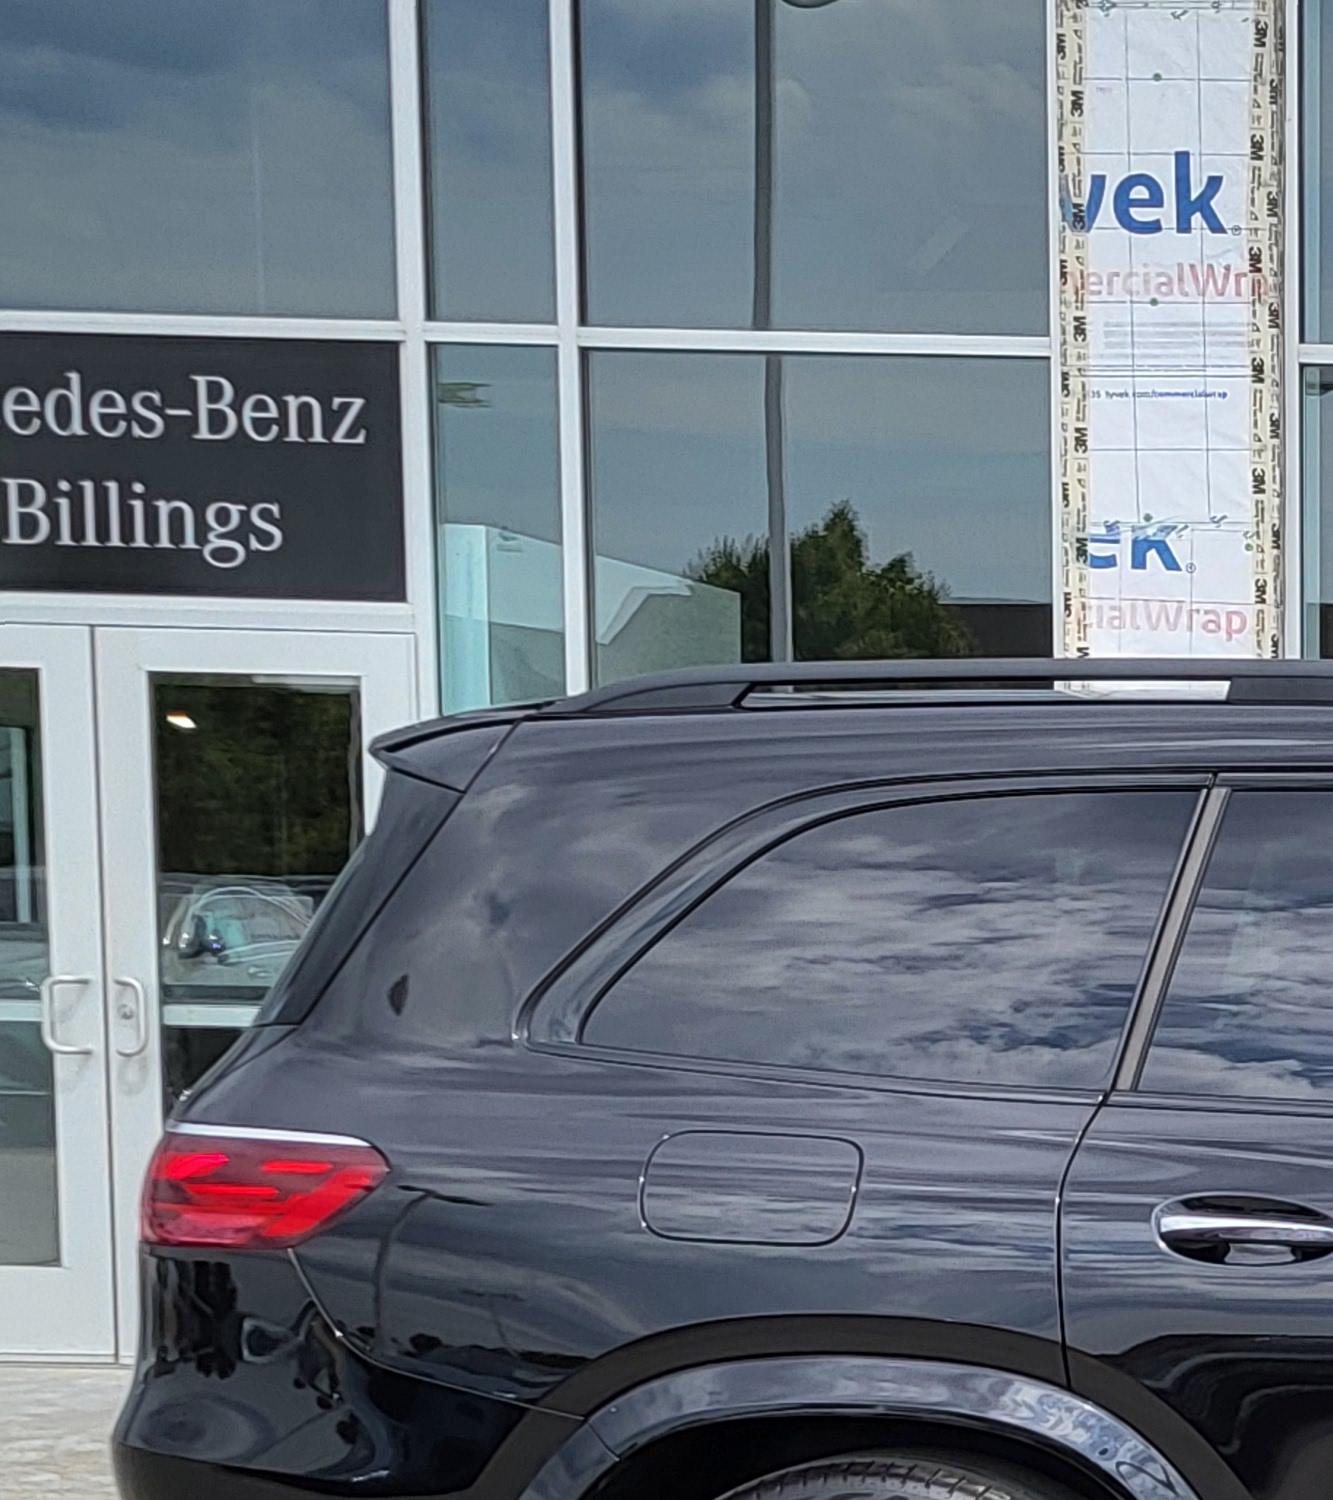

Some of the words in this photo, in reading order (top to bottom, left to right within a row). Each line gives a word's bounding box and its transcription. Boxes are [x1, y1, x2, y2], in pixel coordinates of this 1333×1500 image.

[1254, 20, 1268, 48] 3M
[1071, 90, 1083, 118] 3M
[1250, 134, 1264, 161] 3M
[1249, 246, 1262, 274] 3M
[1074, 316, 1087, 343] 3M
[1251, 357, 1265, 384] 3M
[2, 371, 367, 444] edes-Benz
[1075, 427, 1088, 454] 3M
[1252, 468, 1266, 495] 3M
[2, 478, 283, 568] Billings
[1076, 537, 1088, 564] 3M
[1255, 578, 1267, 604] 3M
[1088, 600, 1248, 642] ialWrap
